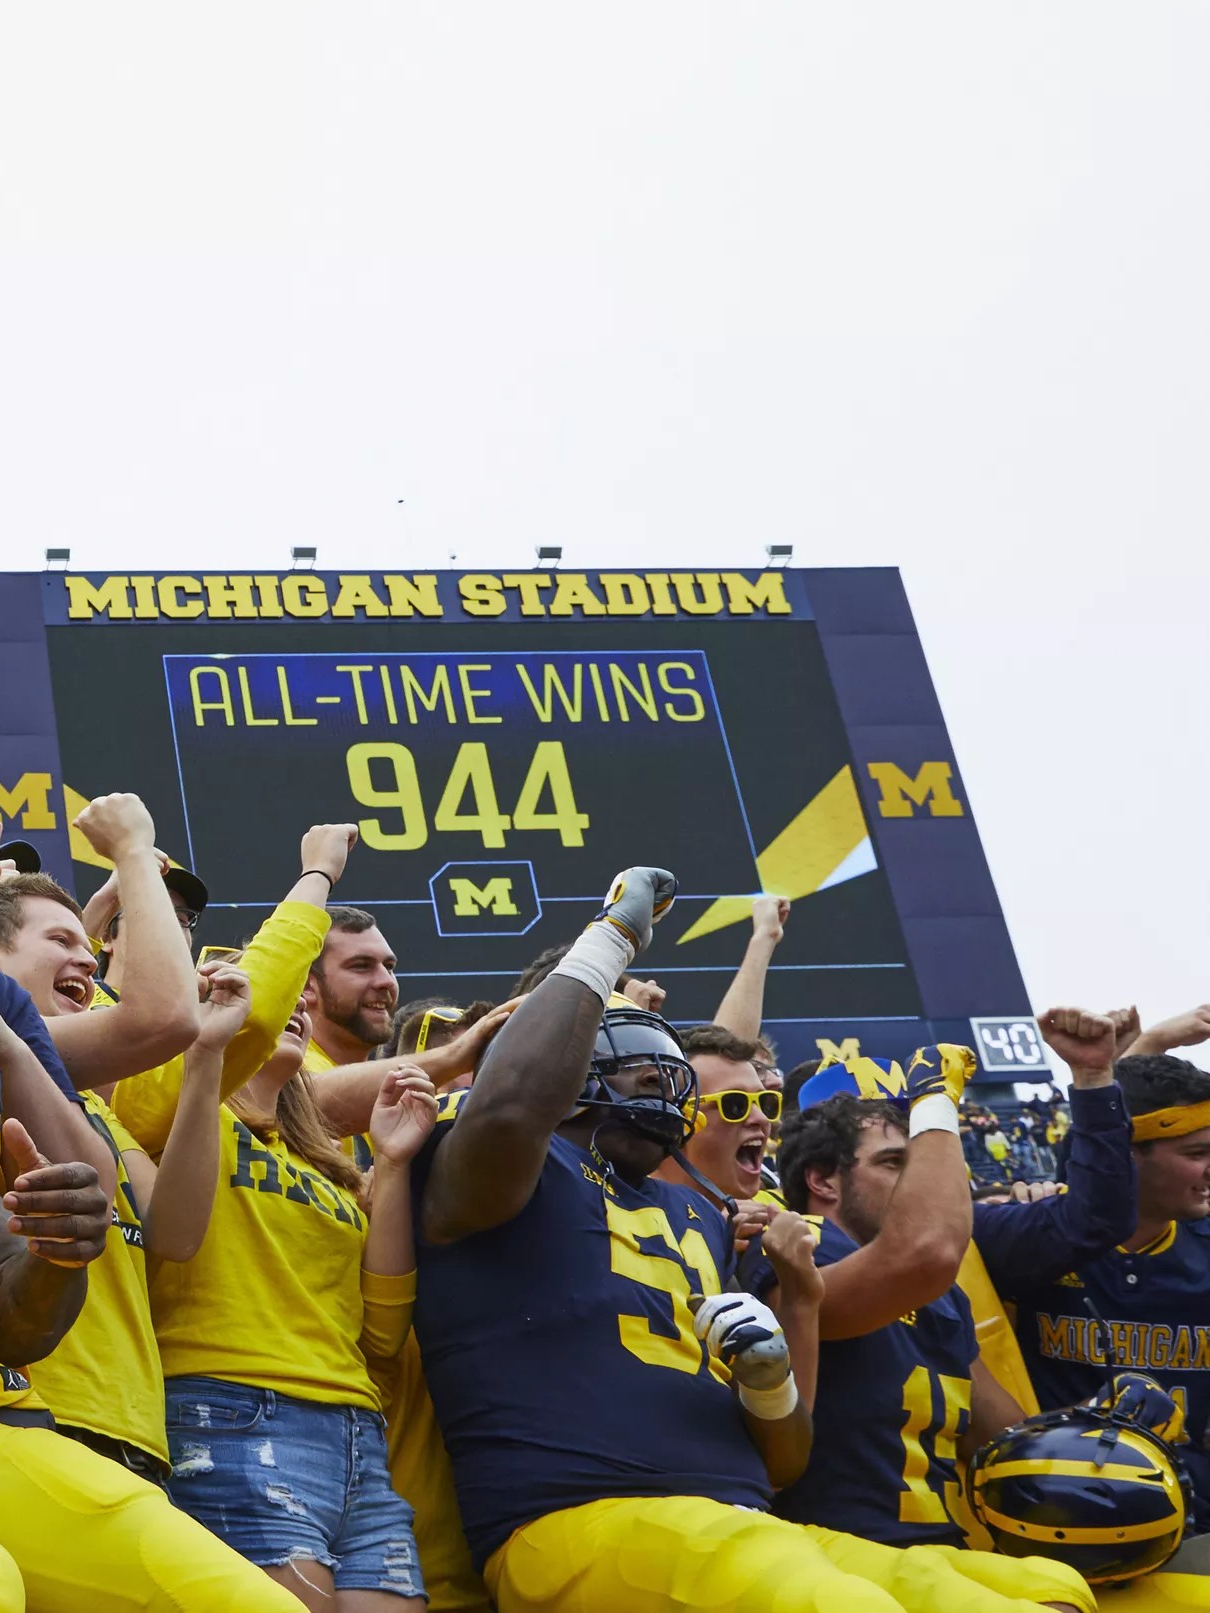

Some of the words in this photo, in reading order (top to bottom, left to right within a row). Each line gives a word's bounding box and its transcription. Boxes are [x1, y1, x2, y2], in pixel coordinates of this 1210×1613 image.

[65, 575, 444, 620] MICHIGAN
[458, 571, 793, 618] STADIUM
[190, 664, 503, 726] ALL-TIME
[515, 662, 705, 723] WINS
[345, 741, 590, 851] 944
[867, 761, 964, 818] M
[448, 877, 518, 916] M
[981, 1023, 1041, 1065] 40
[844, 1057, 909, 1100] M
[1037, 1312, 1210, 1371] MICHIGAN
